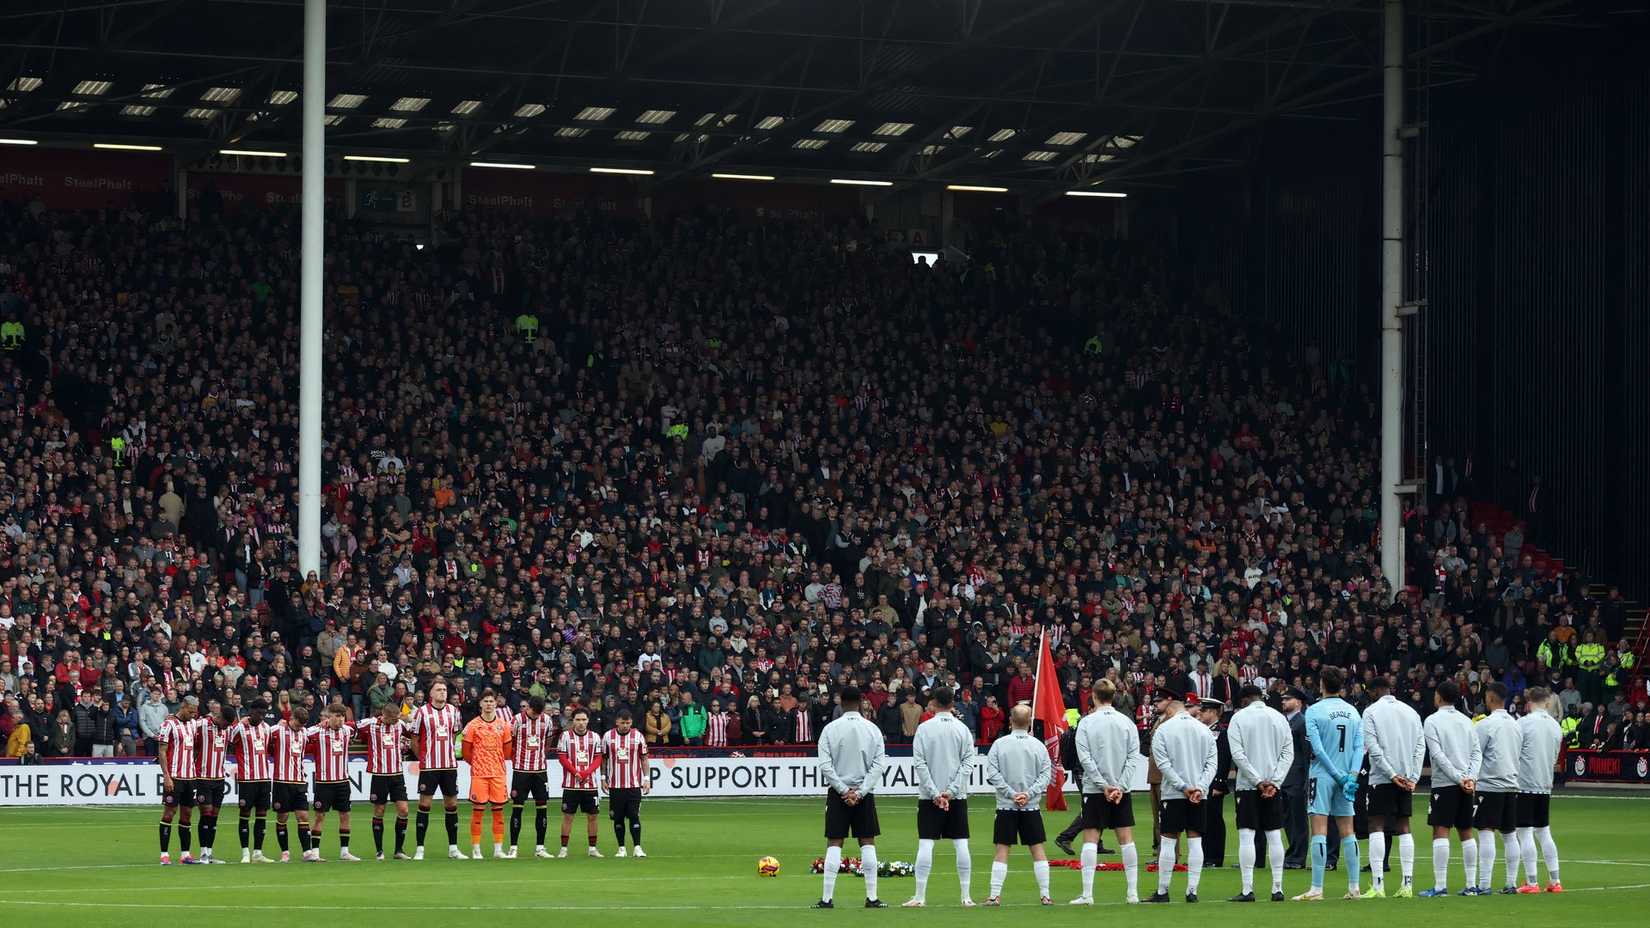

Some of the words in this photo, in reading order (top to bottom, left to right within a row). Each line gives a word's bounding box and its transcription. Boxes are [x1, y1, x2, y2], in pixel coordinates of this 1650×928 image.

[1328, 711, 1352, 721] BEADLE
[1336, 724, 1346, 753] 1
[1, 774, 49, 797] THE
[61, 773, 146, 797] ROYAL
[670, 766, 780, 789] SUPPORT
[881, 765, 919, 787] YAL
